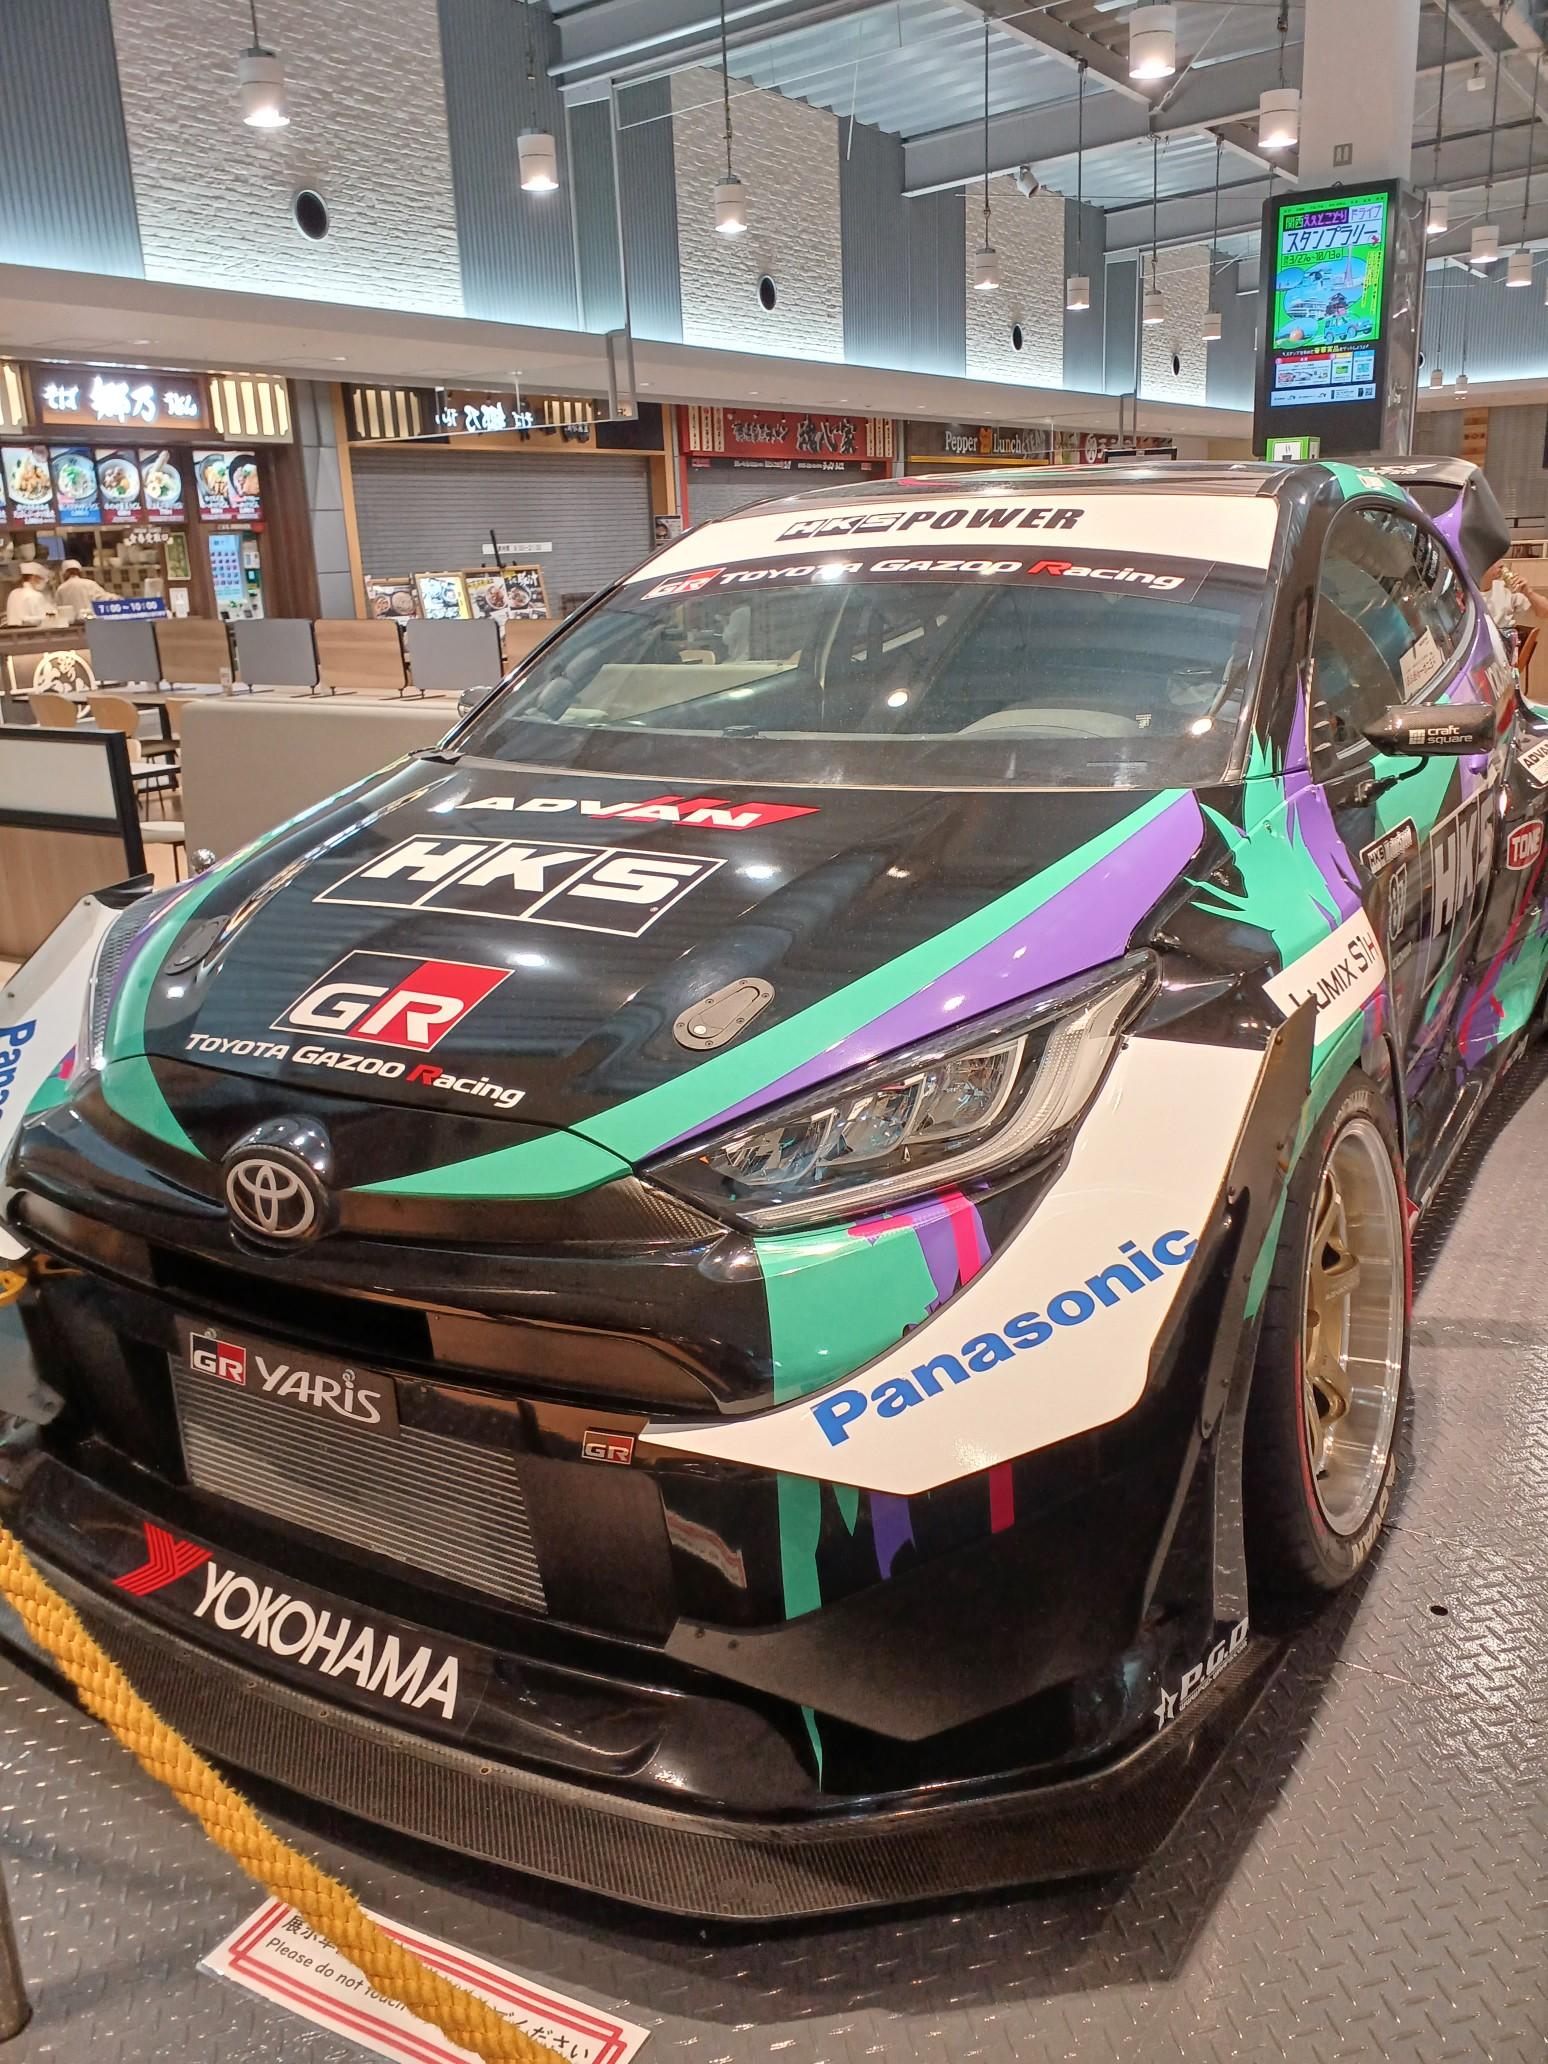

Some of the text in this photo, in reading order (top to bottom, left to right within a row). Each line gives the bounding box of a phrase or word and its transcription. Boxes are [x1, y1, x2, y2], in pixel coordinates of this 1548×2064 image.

[1287, 223, 1378, 253] スタンプラリー
[42, 382, 79, 411] そば
[945, 430, 1022, 454] Pepper Lunch
[777, 507, 1087, 541] HKS POWER
[648, 558, 1187, 600] GR TOYOTA GAZOO Racing
[1427, 735, 1473, 745] square
[460, 795, 765, 828] ADVAN
[1512, 826, 1542, 858] TONE
[361, 838, 702, 906] HKS
[1433, 793, 1493, 940] HKS
[288, 981, 464, 1042] GR
[185, 1033, 526, 1109] TOYOTA GAZOO Racing
[810, 1228, 1198, 1447] Panasonic
[193, 1352, 246, 1385] GR
[585, 1441, 631, 1463] GR
[193, 1560, 461, 1720] YOKOHAMA
[266, 1936, 314, 1968] Please
[315, 1961, 335, 1978] do
[336, 1973, 363, 1990] not
